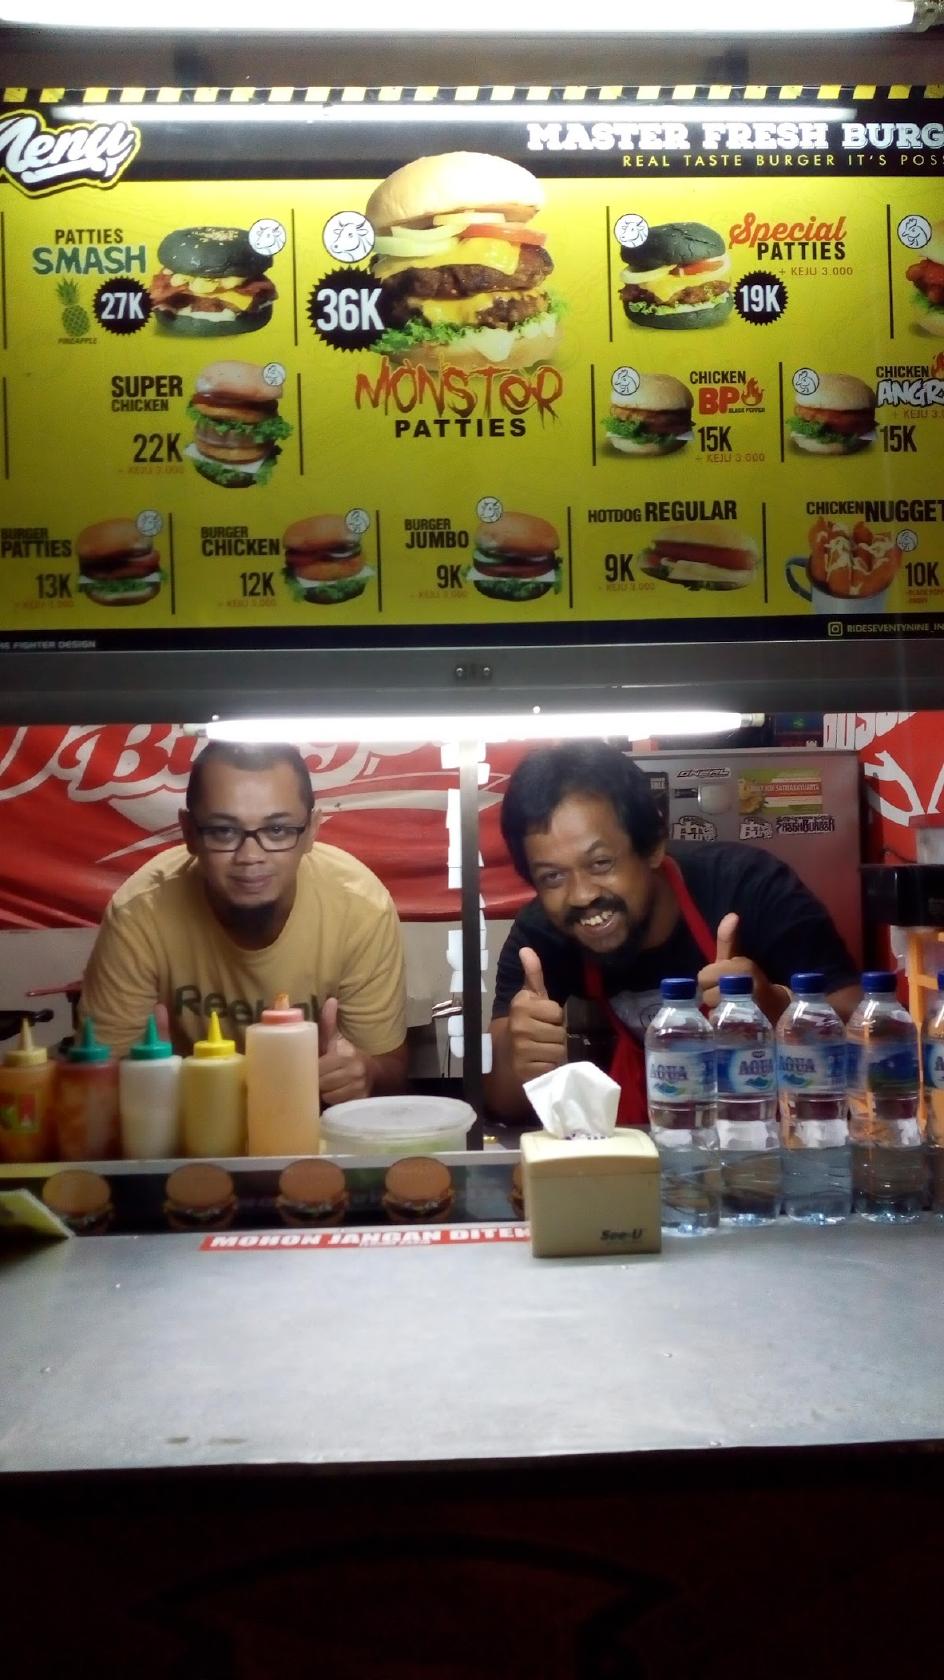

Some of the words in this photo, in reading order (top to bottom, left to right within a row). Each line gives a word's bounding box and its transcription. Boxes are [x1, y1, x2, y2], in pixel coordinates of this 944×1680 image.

[526, 122, 691, 151] MASTER
[702, 122, 829, 150] FRESH
[623, 155, 671, 167] REAL
[683, 154, 743, 167] TASTE
[756, 154, 836, 167] BURGER
[848, 154, 887, 166] IT'S
[54, 228, 124, 245] PATTIES
[728, 212, 847, 249] Special
[32, 245, 146, 275] SMASH
[757, 242, 847, 261] PATTIES
[791, 266, 817, 276] KEJU
[821, 266, 854, 276] 3.000
[100, 291, 145, 320] 27K
[739, 284, 781, 312] 19K
[316, 287, 385, 332] 36K
[690, 371, 746, 385] CHICKEN
[876, 365, 929, 378] CHICKEN
[111, 375, 183, 398] SUPER
[111, 398, 169, 412] CHICKEN
[698, 386, 740, 415] BP
[395, 418, 526, 438] PATTIES
[133, 433, 183, 463] 22K
[697, 425, 732, 453] 15K
[879, 425, 918, 453] 15K
[588, 508, 642, 523] HOTDOG
[645, 500, 738, 522] REGULAR
[806, 501, 865, 515] CHICKEN
[1, 527, 48, 540] BURGER
[201, 526, 249, 538] BURGER
[405, 518, 452, 531] BURGER
[1, 540, 72, 558] PATTIES
[202, 538, 280, 556] CHICKEN
[405, 531, 469, 549] JUMBO
[436, 564, 463, 589] 9K
[605, 554, 635, 582] 9K
[905, 562, 940, 587] 10K
[36, 574, 72, 599] 13K
[240, 572, 275, 597] 12K
[13, 640, 56, 649] FIGHTER
[58, 640, 96, 649] DESIGN
[209, 1234, 322, 1248] MOHON
[327, 1229, 442, 1246] JANGAN
